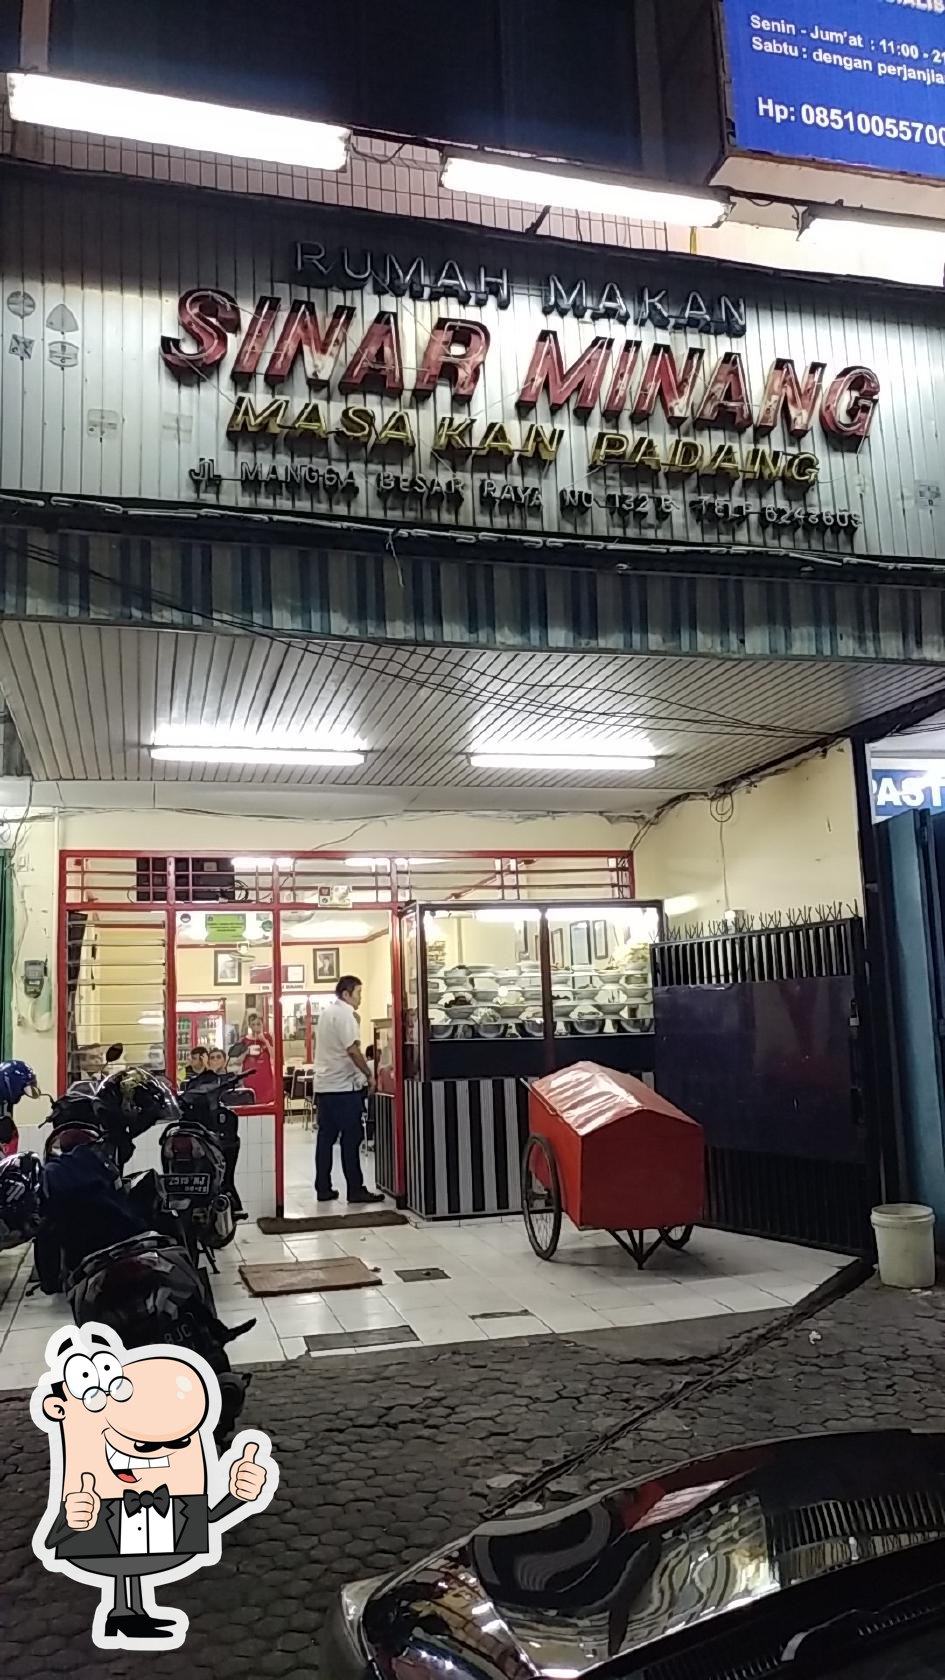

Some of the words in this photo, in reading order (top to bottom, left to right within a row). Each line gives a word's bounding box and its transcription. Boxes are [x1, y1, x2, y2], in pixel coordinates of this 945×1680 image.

[750, 14, 796, 35] Senin
[810, 25, 863, 48] Jum'at
[880, 39, 919, 60] 11:00
[752, 36, 799, 57] Sabtu
[812, 48, 873, 71] dengan
[757, 96, 796, 124] Hp:
[295, 240, 509, 306] RUMAH
[543, 274, 747, 334] MAKAN
[160, 287, 491, 402] SINAR
[515, 329, 881, 441] MINANG
[226, 395, 566, 461] MASAKAN
[588, 430, 821, 484] PADANG
[240, 461, 358, 488] MANGGA
[377, 471, 465, 495] BESAR
[482, 479, 544, 507] RAYA
